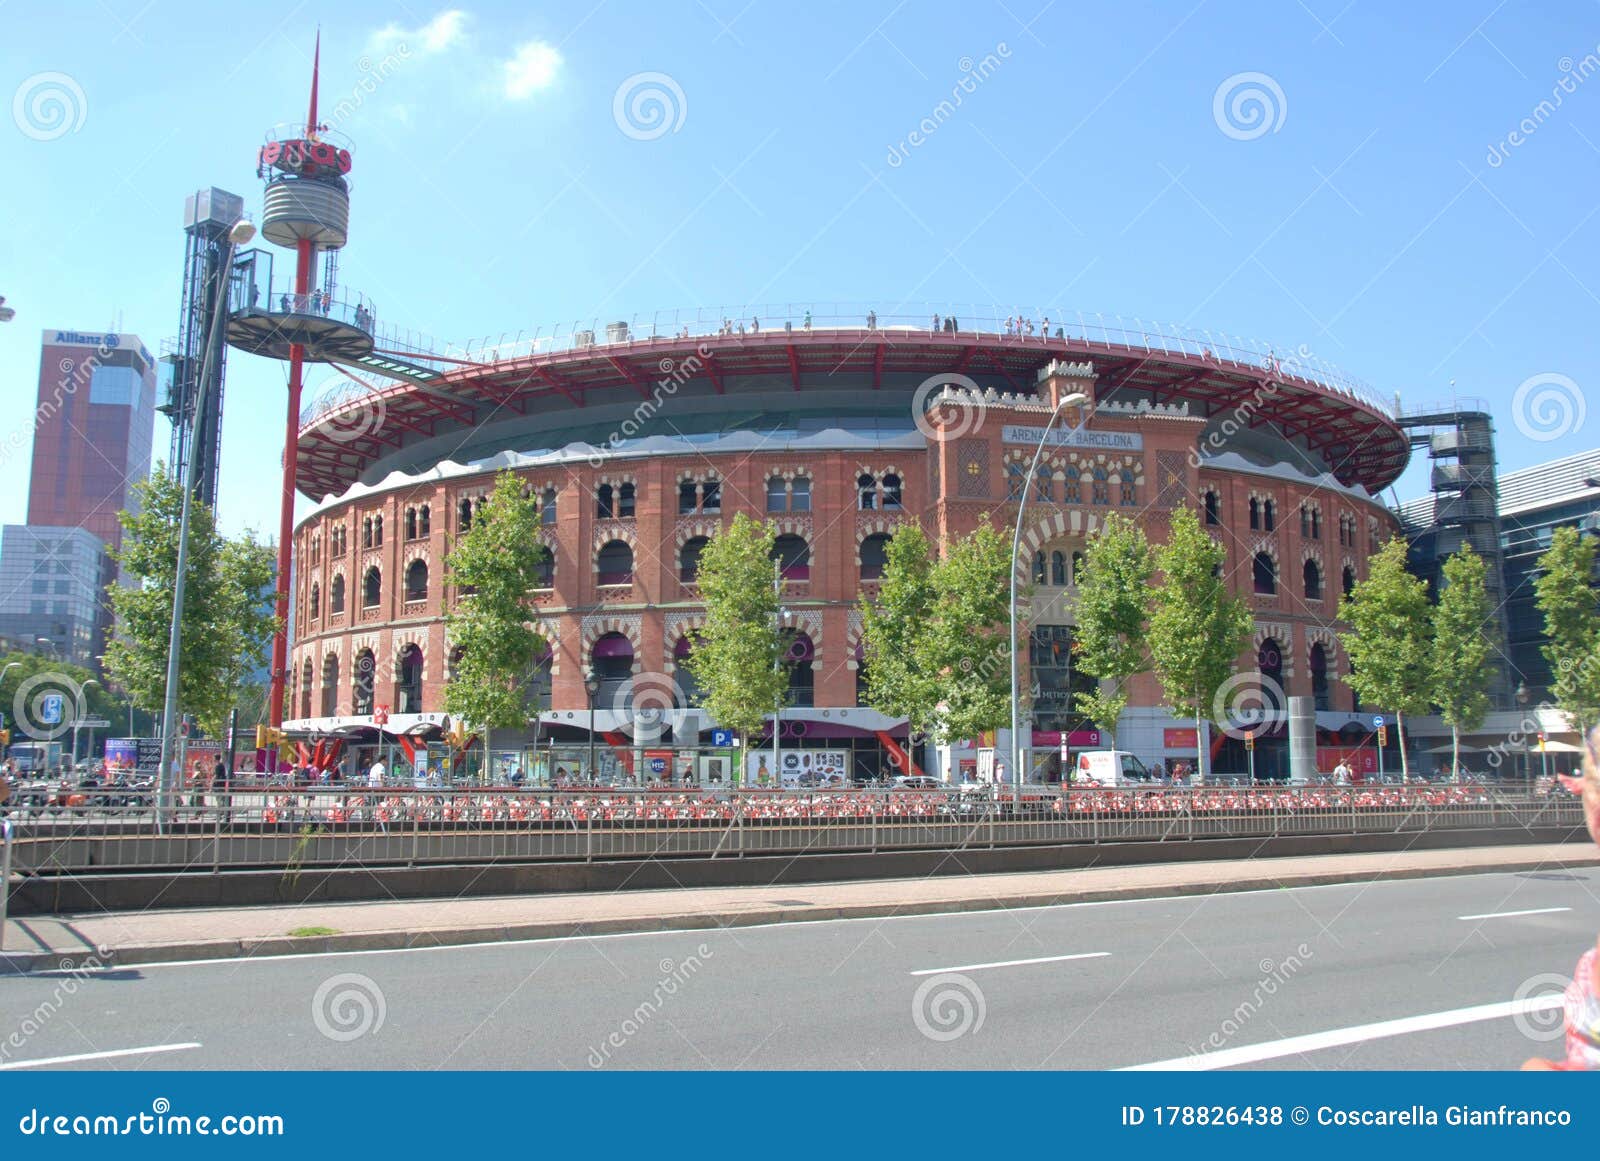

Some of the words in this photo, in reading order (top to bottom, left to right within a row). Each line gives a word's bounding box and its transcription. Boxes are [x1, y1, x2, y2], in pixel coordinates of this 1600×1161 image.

[56, 332, 101, 344] Allianz
[1011, 428, 1050, 442] ARENAS
[1056, 430, 1070, 443] DE
[1075, 433, 1134, 448] BARCELONA
[715, 732, 725, 745] P
